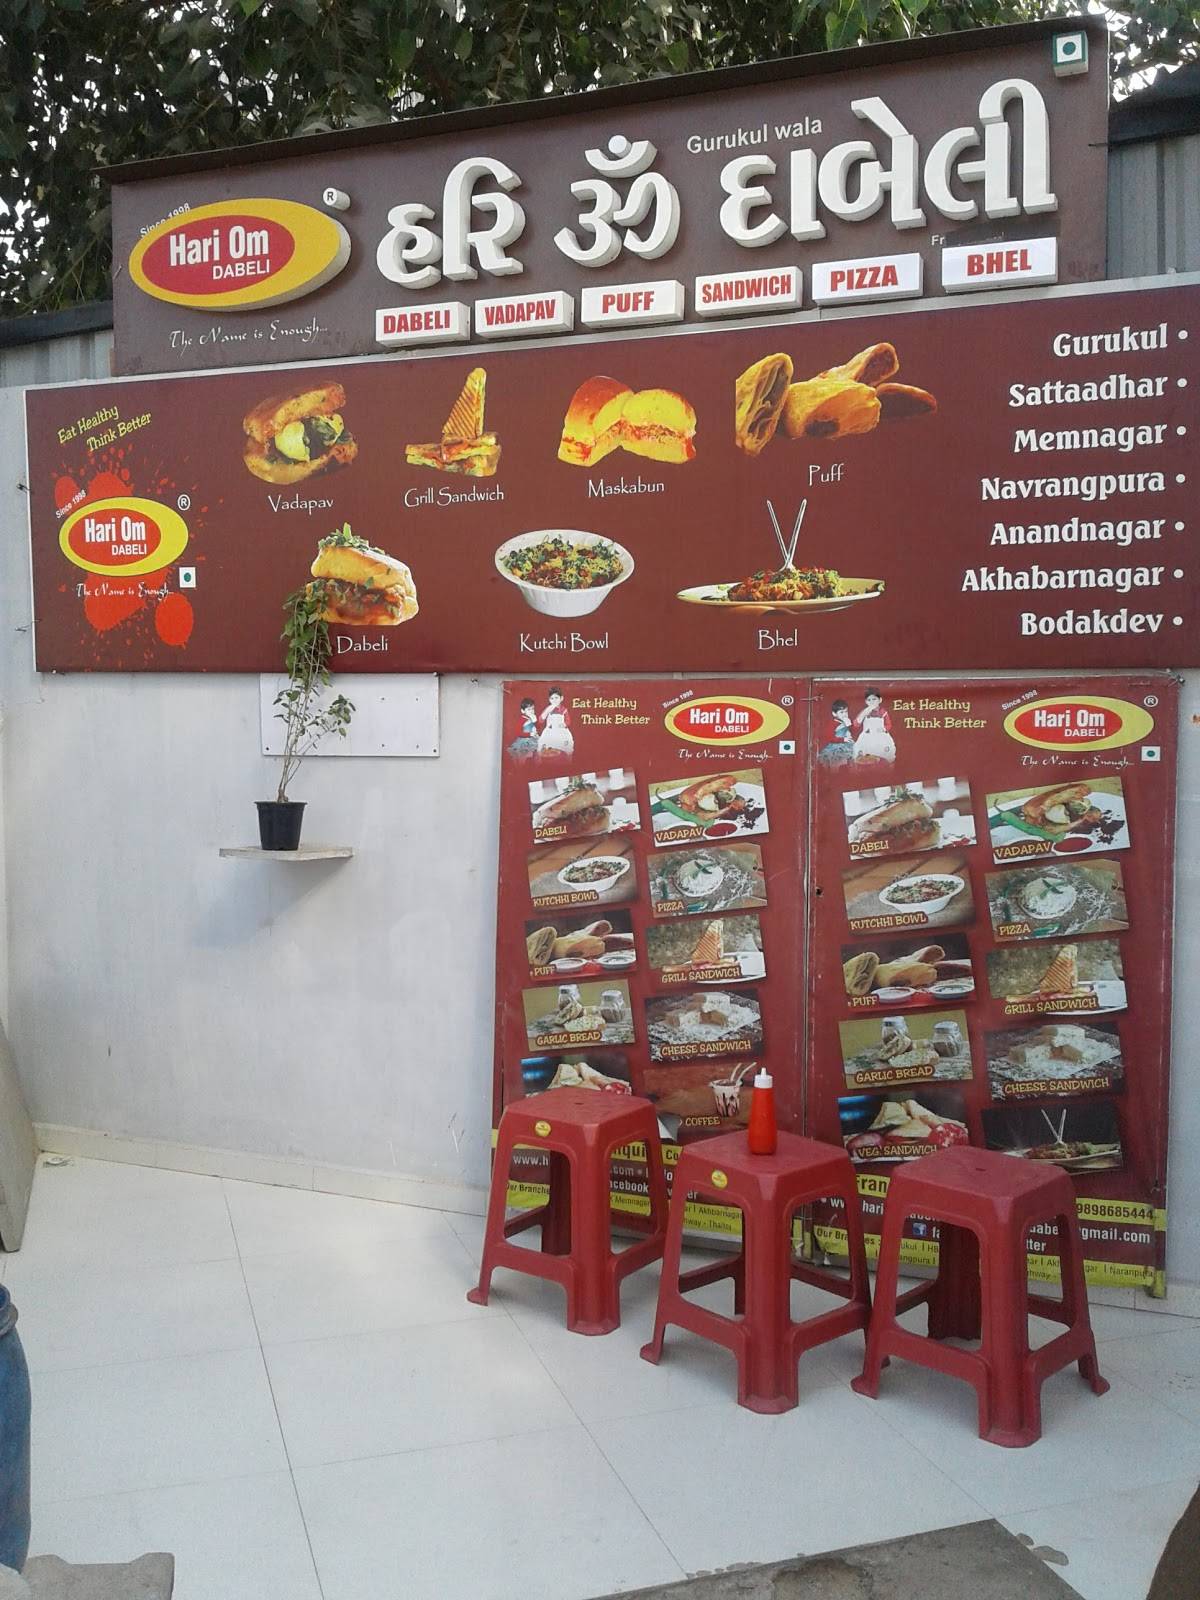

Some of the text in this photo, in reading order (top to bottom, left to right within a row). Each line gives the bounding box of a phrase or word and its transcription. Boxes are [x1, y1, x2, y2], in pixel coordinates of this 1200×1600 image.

[687, 116, 823, 154] Gurukul wala
[376, 156, 525, 290] હરિ
[719, 78, 1058, 248] દાબેલી
[169, 225, 269, 266] Hari Om
[212, 259, 270, 280] DABELI
[967, 249, 1032, 276] BHEL
[830, 264, 899, 292] PIZZA
[701, 273, 792, 303] SANDWICH
[602, 290, 655, 314] PUFF
[383, 309, 451, 335] DABELI
[484, 300, 556, 326] VADAPAV
[169, 330, 193, 358] The
[200, 326, 248, 345] Name
[253, 328, 263, 339] is
[1053, 323, 1168, 357] Gurukul
[1008, 374, 1168, 407] Sattaadhar
[57, 405, 120, 444] Eat Healthy
[86, 412, 152, 452] Think Better
[1014, 424, 1168, 453] Memnagar
[808, 463, 845, 486] Puff
[588, 477, 665, 498] Maskabun
[981, 471, 1166, 501] Navrangpura
[267, 494, 334, 515] Vadapav
[404, 484, 504, 508] Grill Sandwich
[84, 516, 146, 543] Hari Om
[990, 517, 1166, 547] Anandnagar
[111, 543, 147, 556] DABELI
[961, 565, 1165, 593] Akhabarnagar
[76, 583, 91, 598] The
[94, 582, 125, 596] Name
[128, 586, 135, 595] is
[1020, 609, 1164, 636] Bodakdev
[336, 634, 388, 654] Dabeli
[519, 632, 609, 653] Kutchi Bowl
[758, 629, 798, 650] Bhel
[572, 698, 637, 711] Eat Healthy
[893, 698, 971, 713] Eat Healthy
[581, 714, 651, 725] Think Better
[690, 708, 749, 724] Hari Om
[904, 717, 987, 729] Think Better
[1034, 709, 1104, 727] Hari Om
[715, 725, 750, 733] DABELI
[1064, 728, 1106, 737] DABELI
[679, 748, 692, 762] The
[696, 748, 725, 759] Name
[1021, 755, 1037, 770] The
[1043, 755, 1077, 766] Name
[535, 826, 567, 838] DABELI
[655, 827, 703, 842] VADAPAV
[851, 840, 889, 854] DABELI
[994, 841, 1051, 858] VADAPAV
[533, 890, 598, 907] KUTCHHI BOWL
[656, 901, 684, 913] PIZZA
[850, 912, 927, 930] KUTCHHI BOWL
[999, 923, 1031, 936] PIZZA
[534, 965, 555, 977] PUFF
[661, 967, 741, 983] GRILL SANDWICH
[852, 995, 878, 1007] PUFF
[1004, 998, 1097, 1015] GRILL SANDWICH
[537, 1031, 601, 1046] GARLIC BREAD
[661, 1039, 751, 1056] CHEESE SANDWICH
[856, 1065, 933, 1083] GARLIC BREAD
[1005, 1076, 1109, 1094] CHEESE SANDWICH
[685, 1116, 721, 1127] COFFEE
[883, 1144, 938, 1157] SANDWICH
